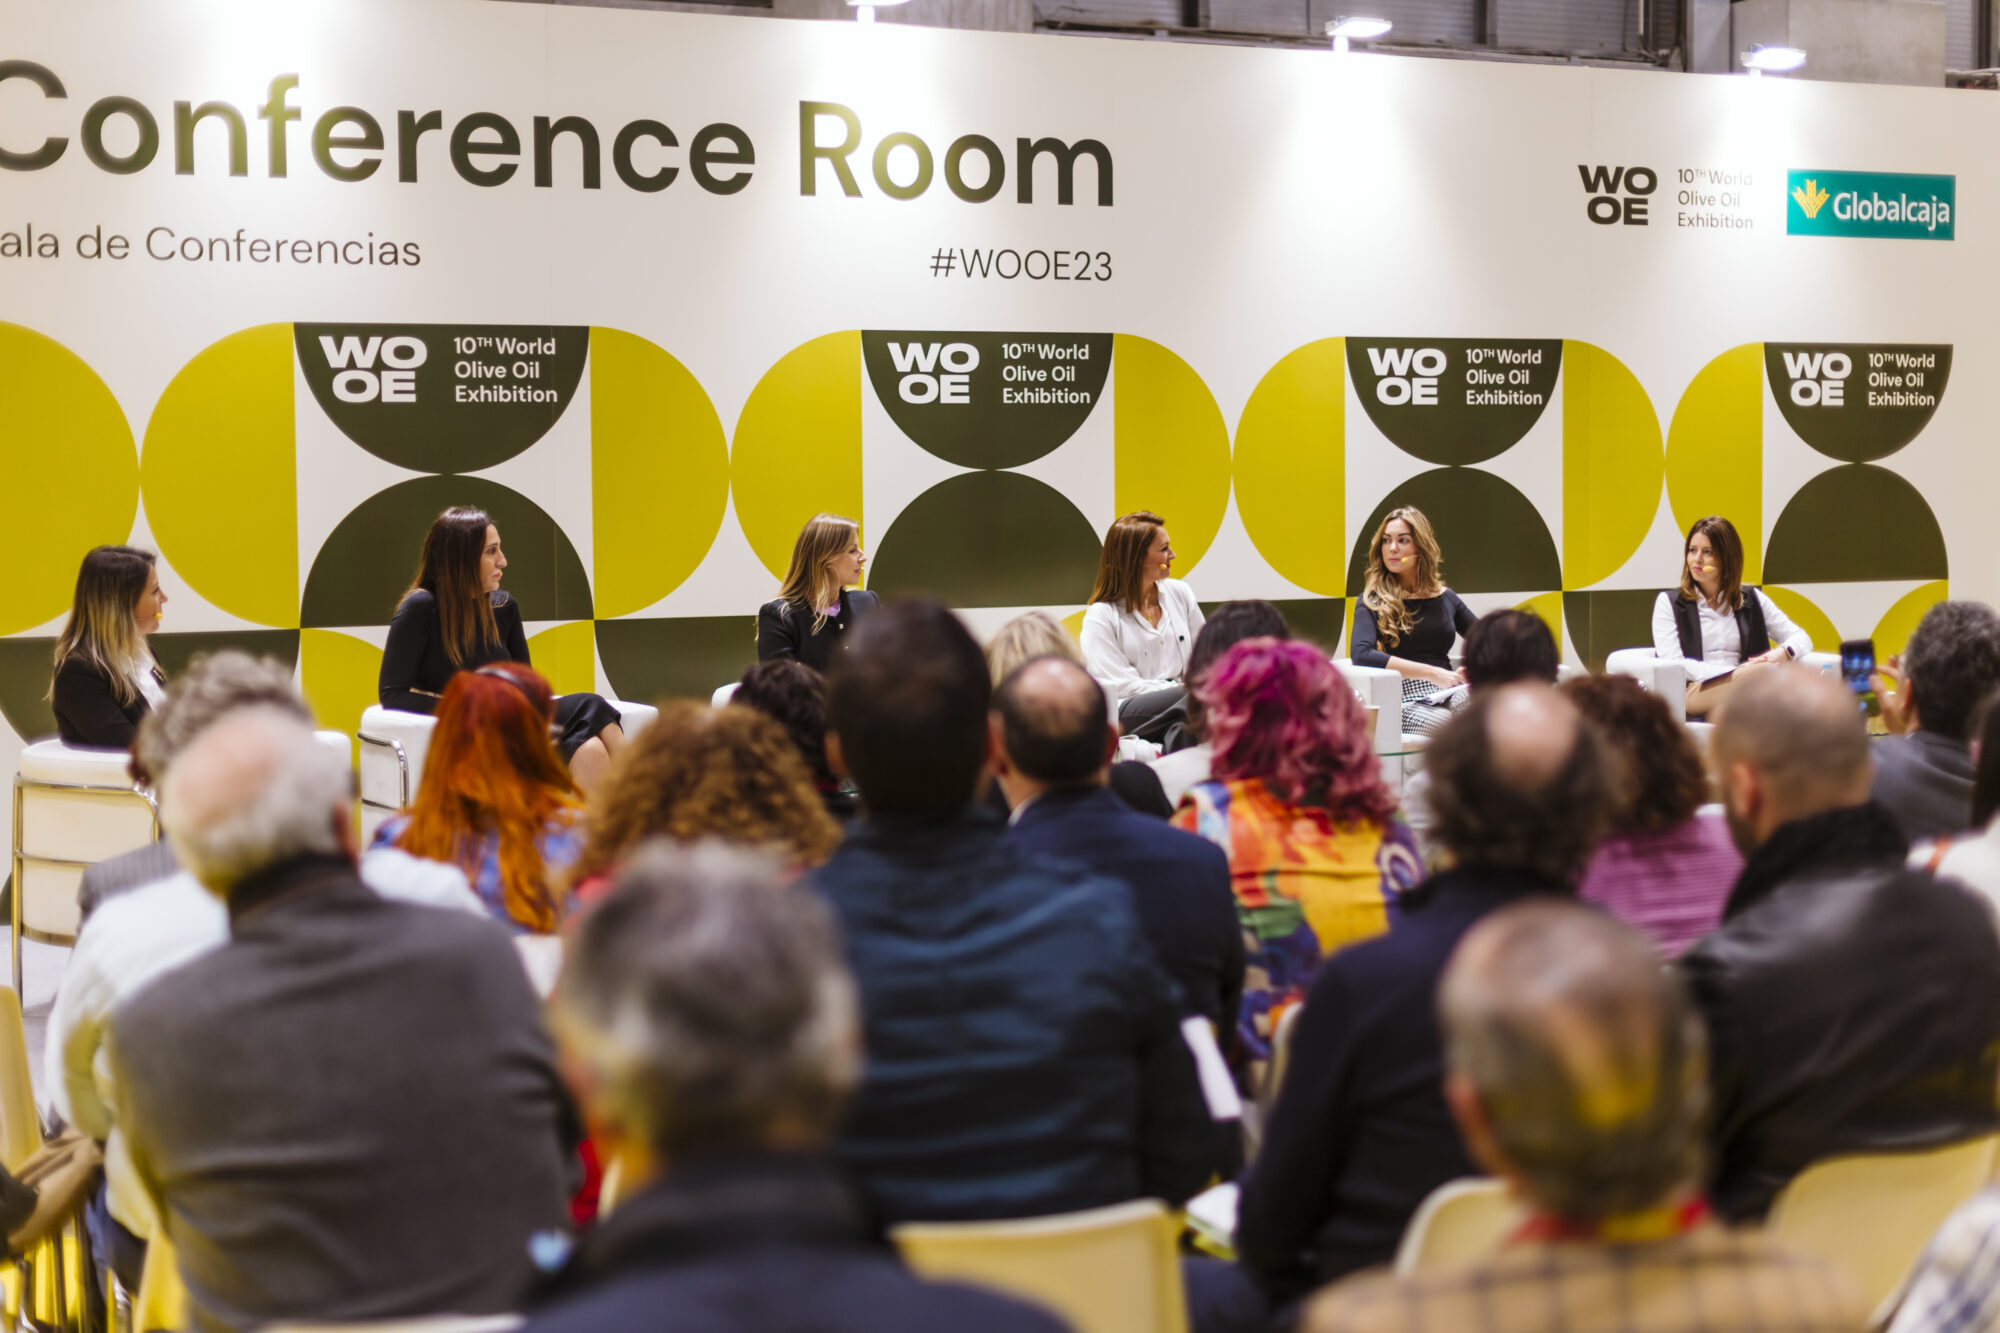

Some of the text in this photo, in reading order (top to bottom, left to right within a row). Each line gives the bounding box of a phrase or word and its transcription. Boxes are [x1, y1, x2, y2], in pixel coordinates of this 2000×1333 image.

[0, 59, 1114, 207] Conference Room
[1578, 164, 1658, 195] WO
[1708, 169, 1753, 186] World
[1677, 190, 1741, 208] Olive Oil
[1587, 196, 1649, 226] OE
[1677, 212, 1754, 229] Exhibition
[1833, 192, 1950, 231] Globalcaja
[76, 224, 130, 260] de
[145, 226, 422, 267] Conferencias
[930, 247, 1113, 282] #WOOE23
[318, 335, 428, 369] WO
[495, 337, 556, 355] World
[1037, 343, 1089, 361] World
[887, 342, 980, 373] WO
[1366, 347, 1447, 377] WO
[1496, 348, 1542, 364] World
[1782, 352, 1853, 379] WO
[1895, 353, 1935, 368] World
[454, 360, 540, 379] Olive Oil
[1002, 365, 1075, 382] Olive Oil
[1466, 369, 1530, 385] Olive Oil
[1868, 371, 1924, 387] Olive Oil
[332, 369, 417, 403] OE
[455, 384, 558, 403] Exhibition
[898, 374, 970, 405] OE
[1376, 377, 1438, 406] OE
[1790, 380, 1845, 407] OE
[1003, 387, 1091, 405] Exhibition
[1466, 390, 1543, 406] Exhibition
[1868, 391, 1935, 407] Exhibition
